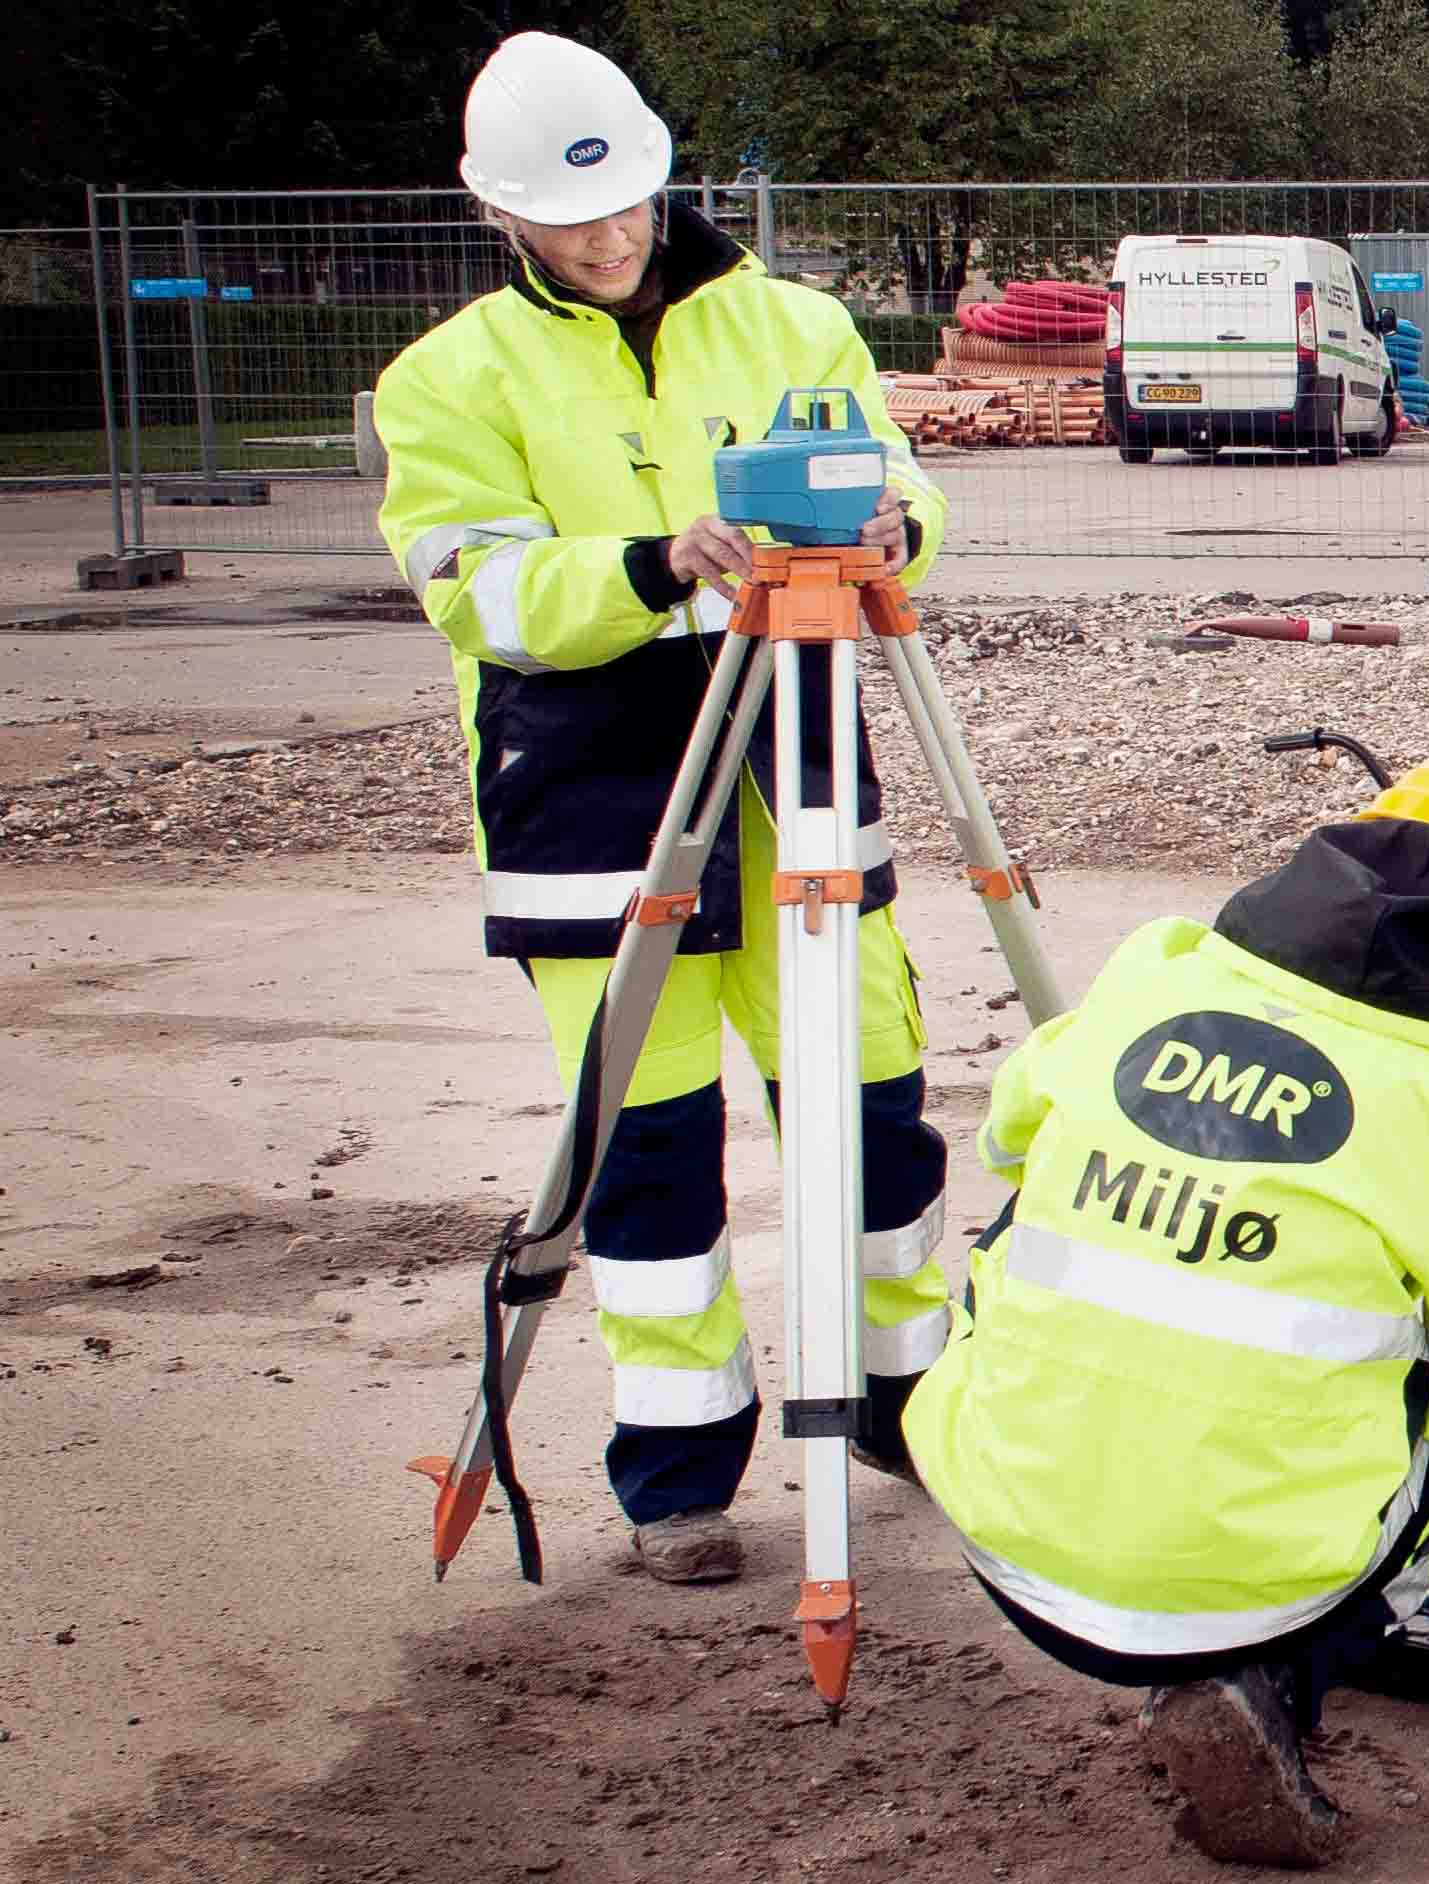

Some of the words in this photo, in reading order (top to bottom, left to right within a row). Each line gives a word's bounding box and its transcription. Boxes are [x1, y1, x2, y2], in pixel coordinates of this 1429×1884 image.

[571, 144, 604, 162] DMR
[1139, 271, 1268, 286] HYLLESTED
[1072, 1149, 1281, 1263] Miljø
